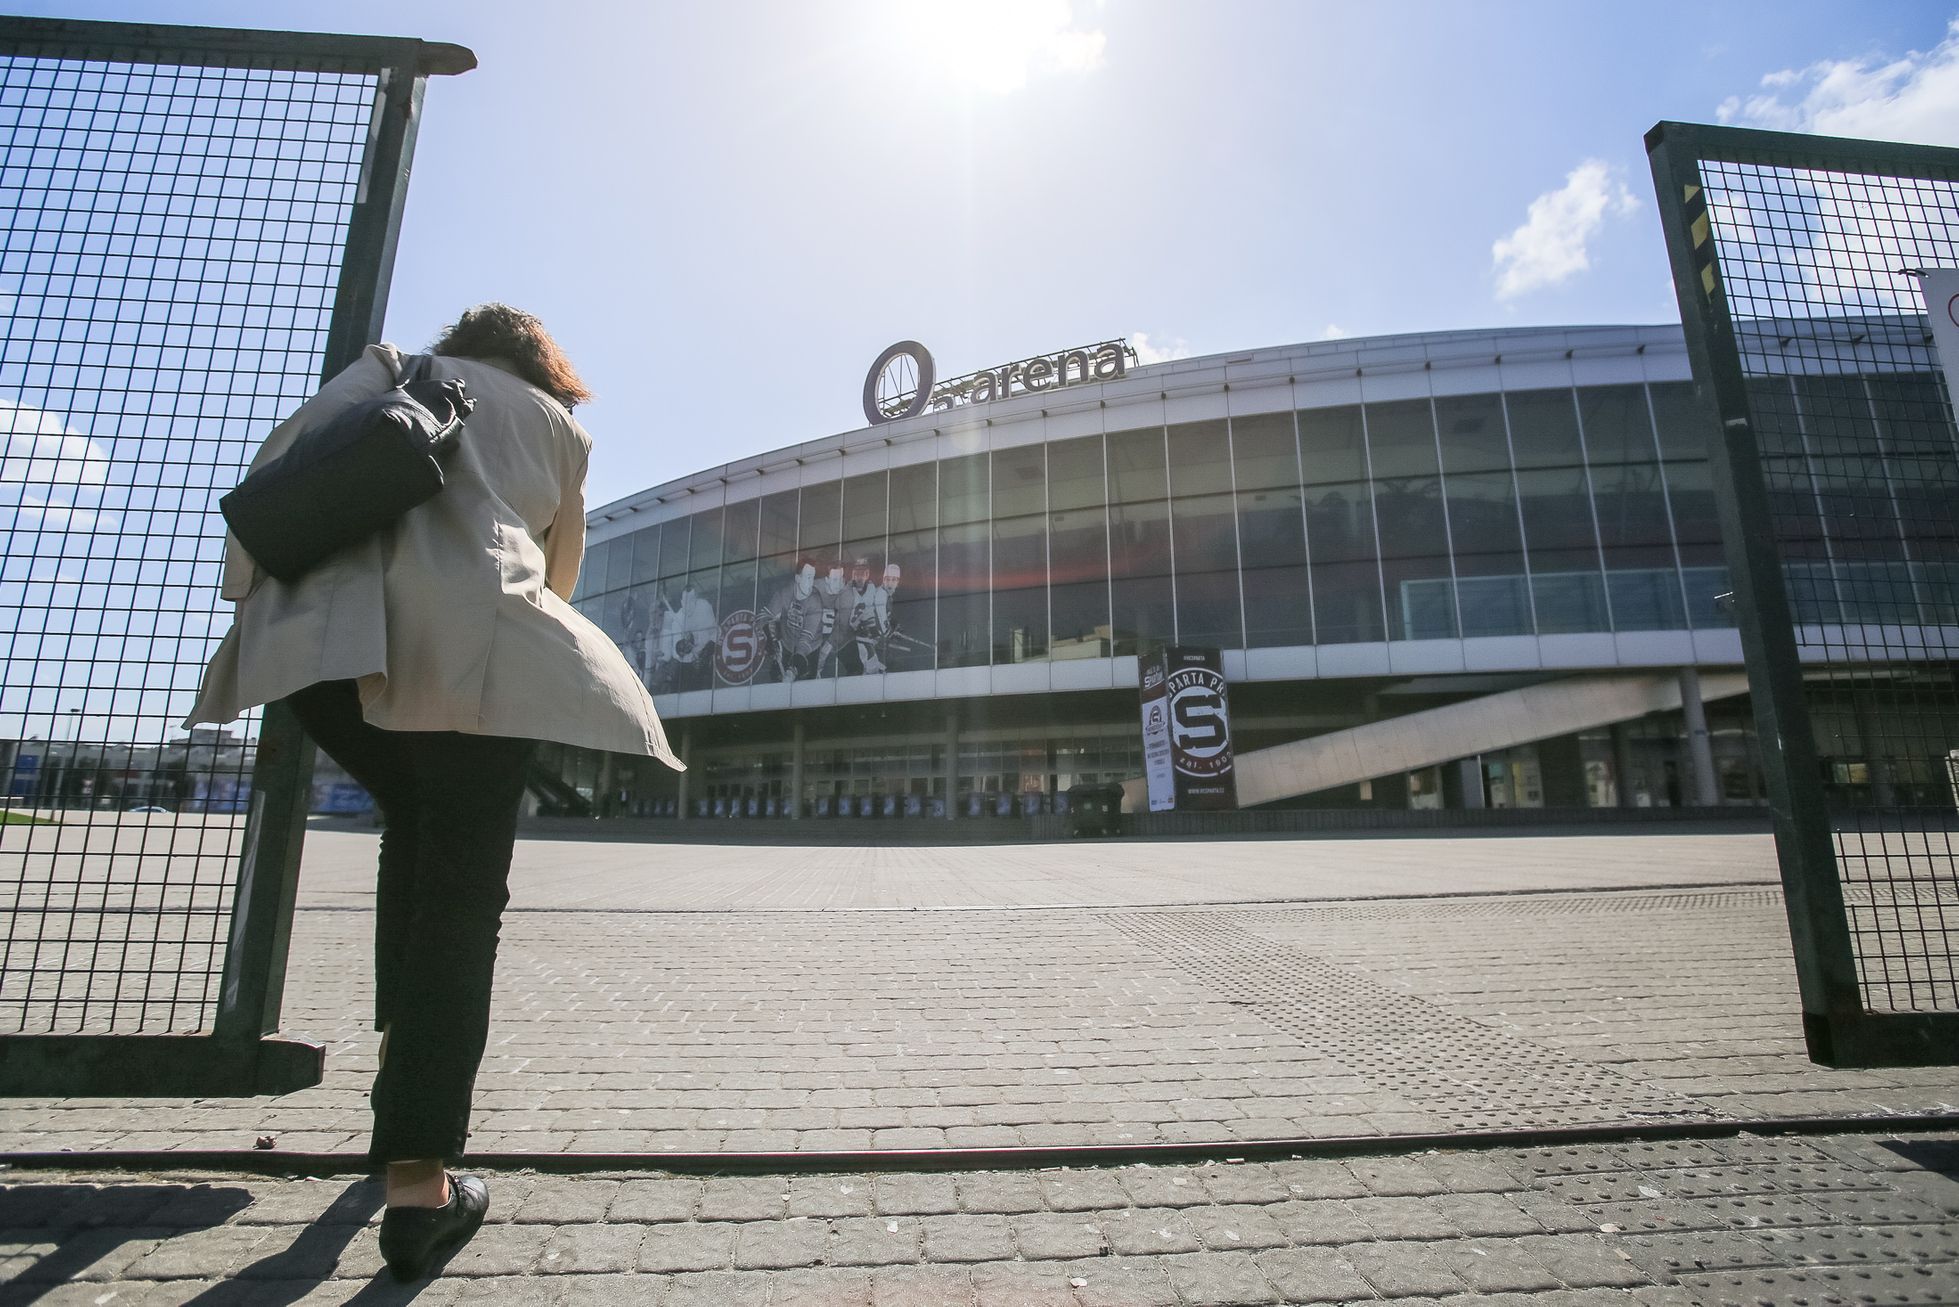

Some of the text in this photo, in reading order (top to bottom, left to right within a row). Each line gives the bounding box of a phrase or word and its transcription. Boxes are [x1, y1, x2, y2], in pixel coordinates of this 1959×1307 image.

[971, 343, 1127, 405] arena
[725, 629, 753, 665] S
[1168, 672, 1205, 698] PARTA
[1209, 677, 1226, 698] PR
[1174, 694, 1229, 751] S
